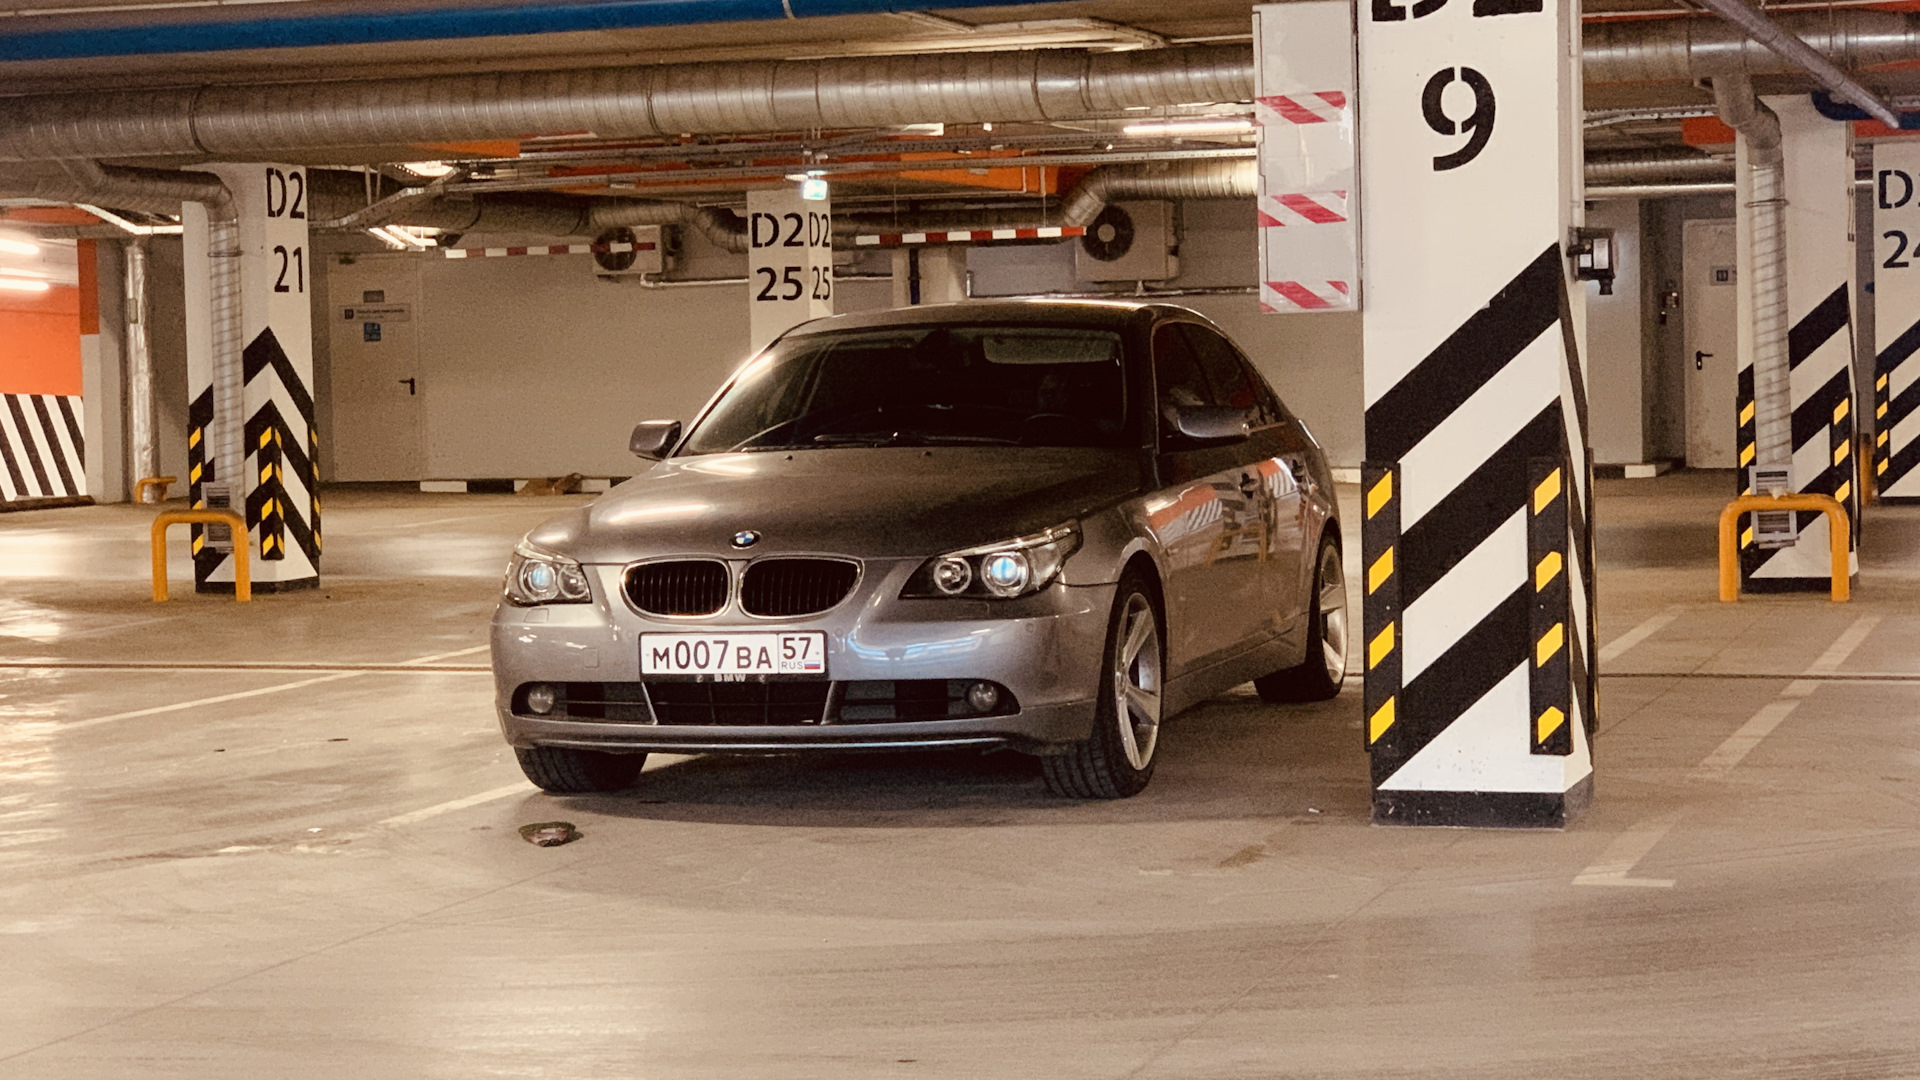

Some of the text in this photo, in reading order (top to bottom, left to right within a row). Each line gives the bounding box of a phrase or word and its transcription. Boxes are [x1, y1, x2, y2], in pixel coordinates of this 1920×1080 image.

[1421, 66, 1496, 172] 9
[266, 167, 305, 219] D2
[1878, 169, 1920, 209] D
[751, 212, 804, 248] D2
[808, 211, 831, 248] D2
[1883, 230, 1920, 269] 2
[273, 245, 304, 293] 21
[756, 266, 803, 301] 25
[812, 266, 831, 300] 25
[781, 661, 804, 670] RUS
[782, 636, 811, 660] 57
[714, 673, 747, 683] BMW
